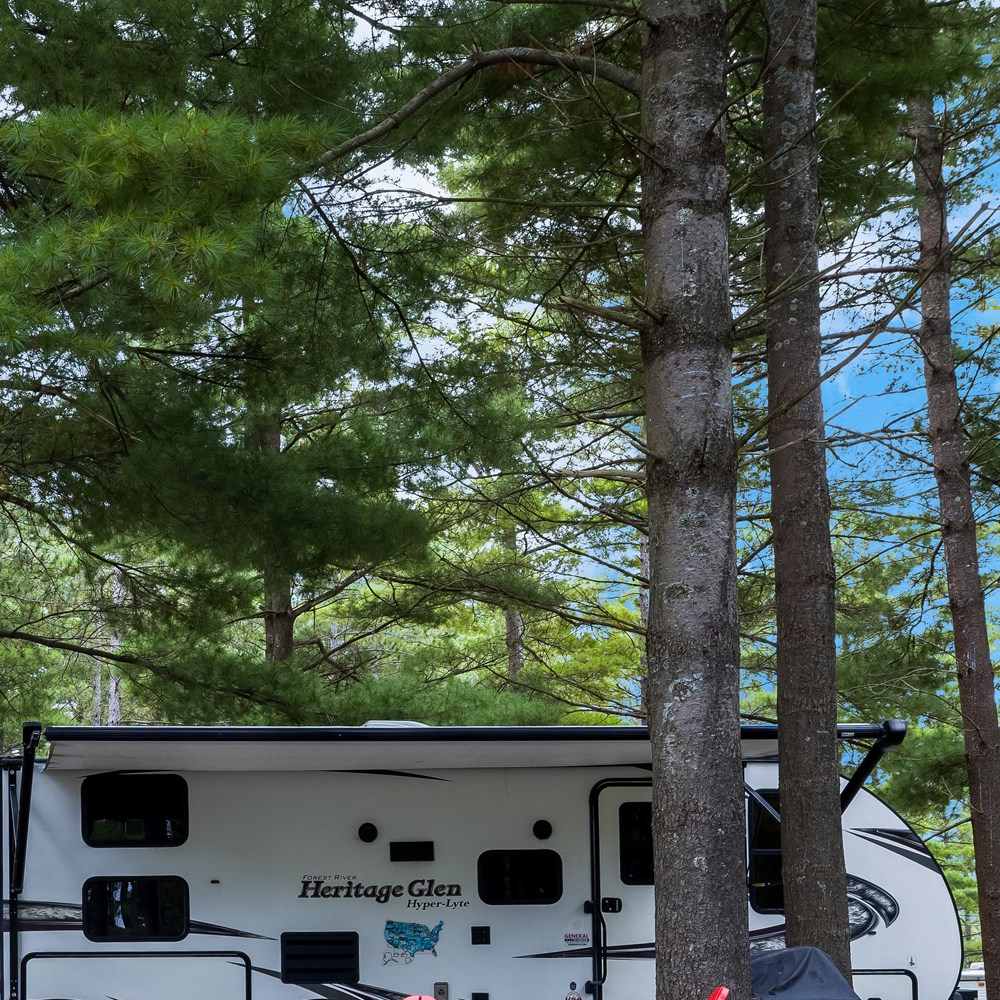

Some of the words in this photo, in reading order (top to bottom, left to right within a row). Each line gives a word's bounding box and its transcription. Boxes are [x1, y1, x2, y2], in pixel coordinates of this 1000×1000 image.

[298, 880, 404, 904] Heritage
[407, 879, 462, 898] Glen
[406, 899, 470, 911] Hyper-Lyte
